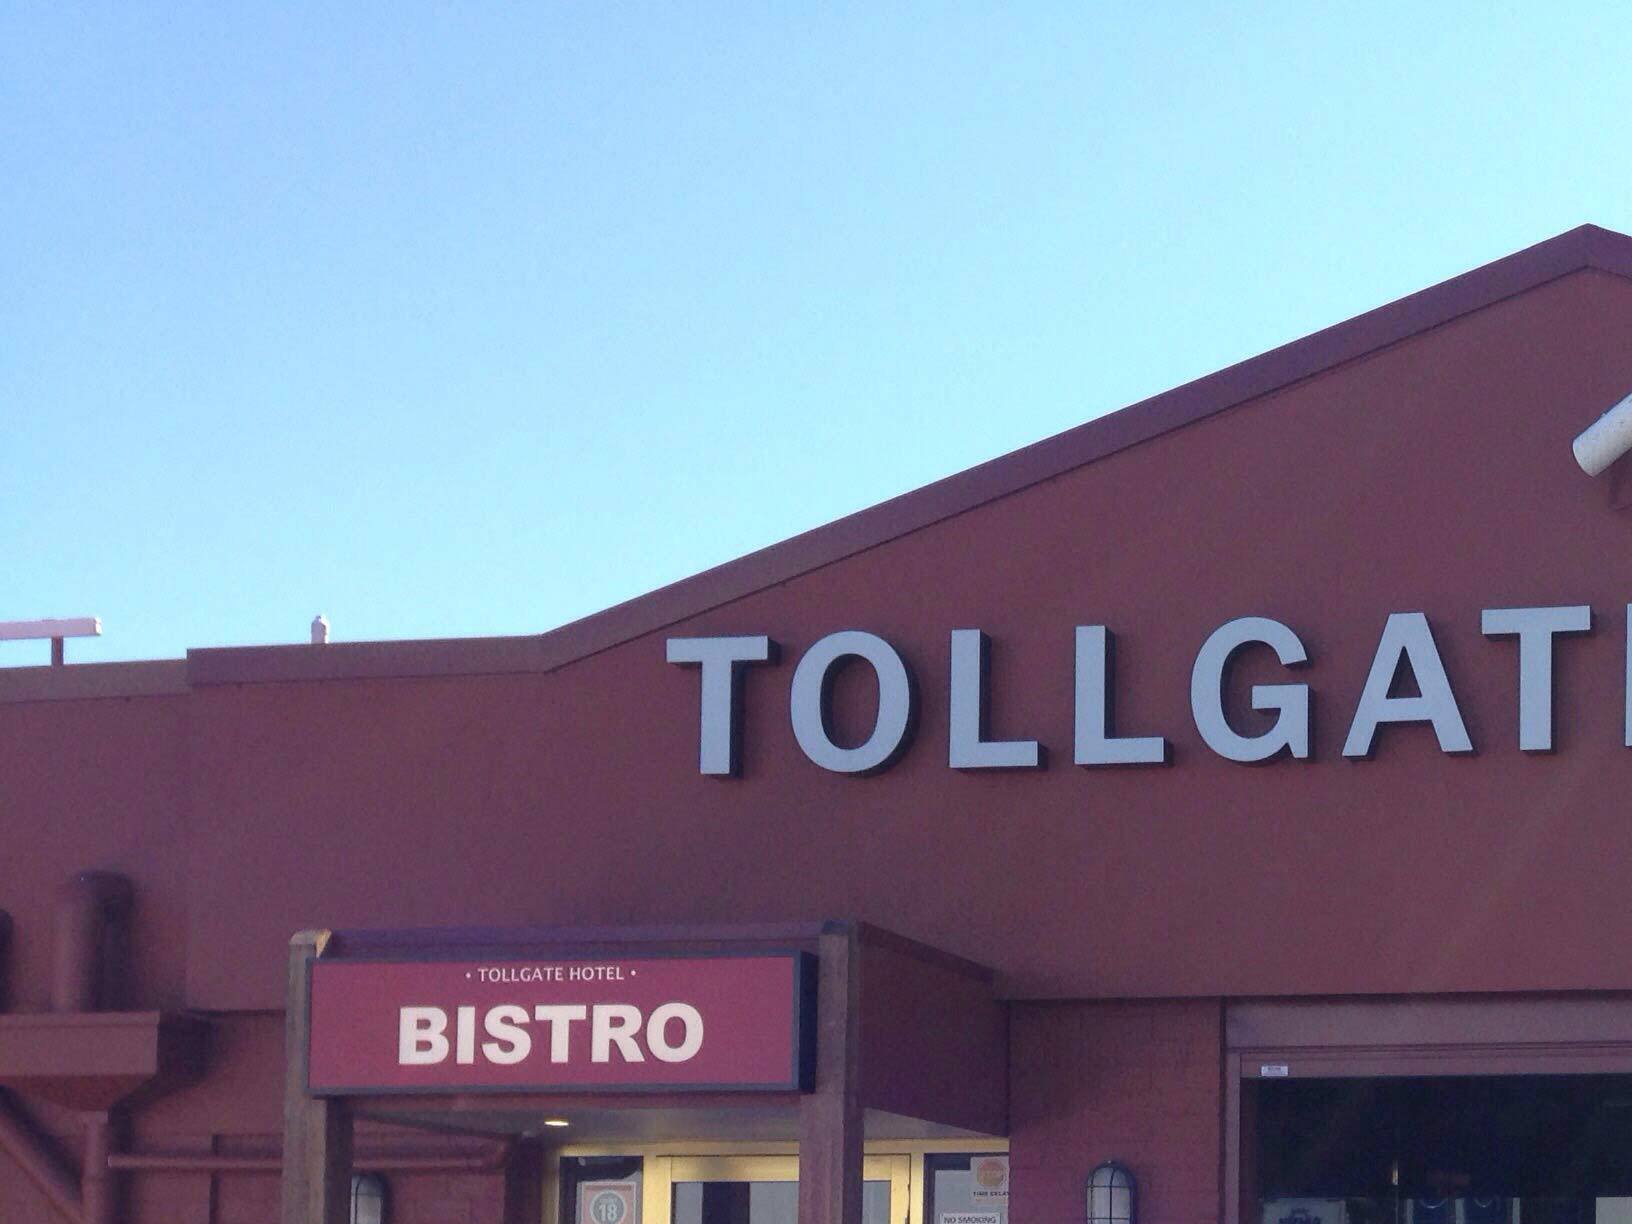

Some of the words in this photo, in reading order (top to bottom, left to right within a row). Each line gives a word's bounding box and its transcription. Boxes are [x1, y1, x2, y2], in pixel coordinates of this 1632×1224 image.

[477, 966, 564, 983] TOLLGATE
[568, 966, 625, 982] HOTEL
[398, 1001, 704, 1066] BISTRO
[598, 1203, 618, 1222] 18
[944, 1215, 957, 1224] NO
[958, 1215, 997, 1224] SMOKING
